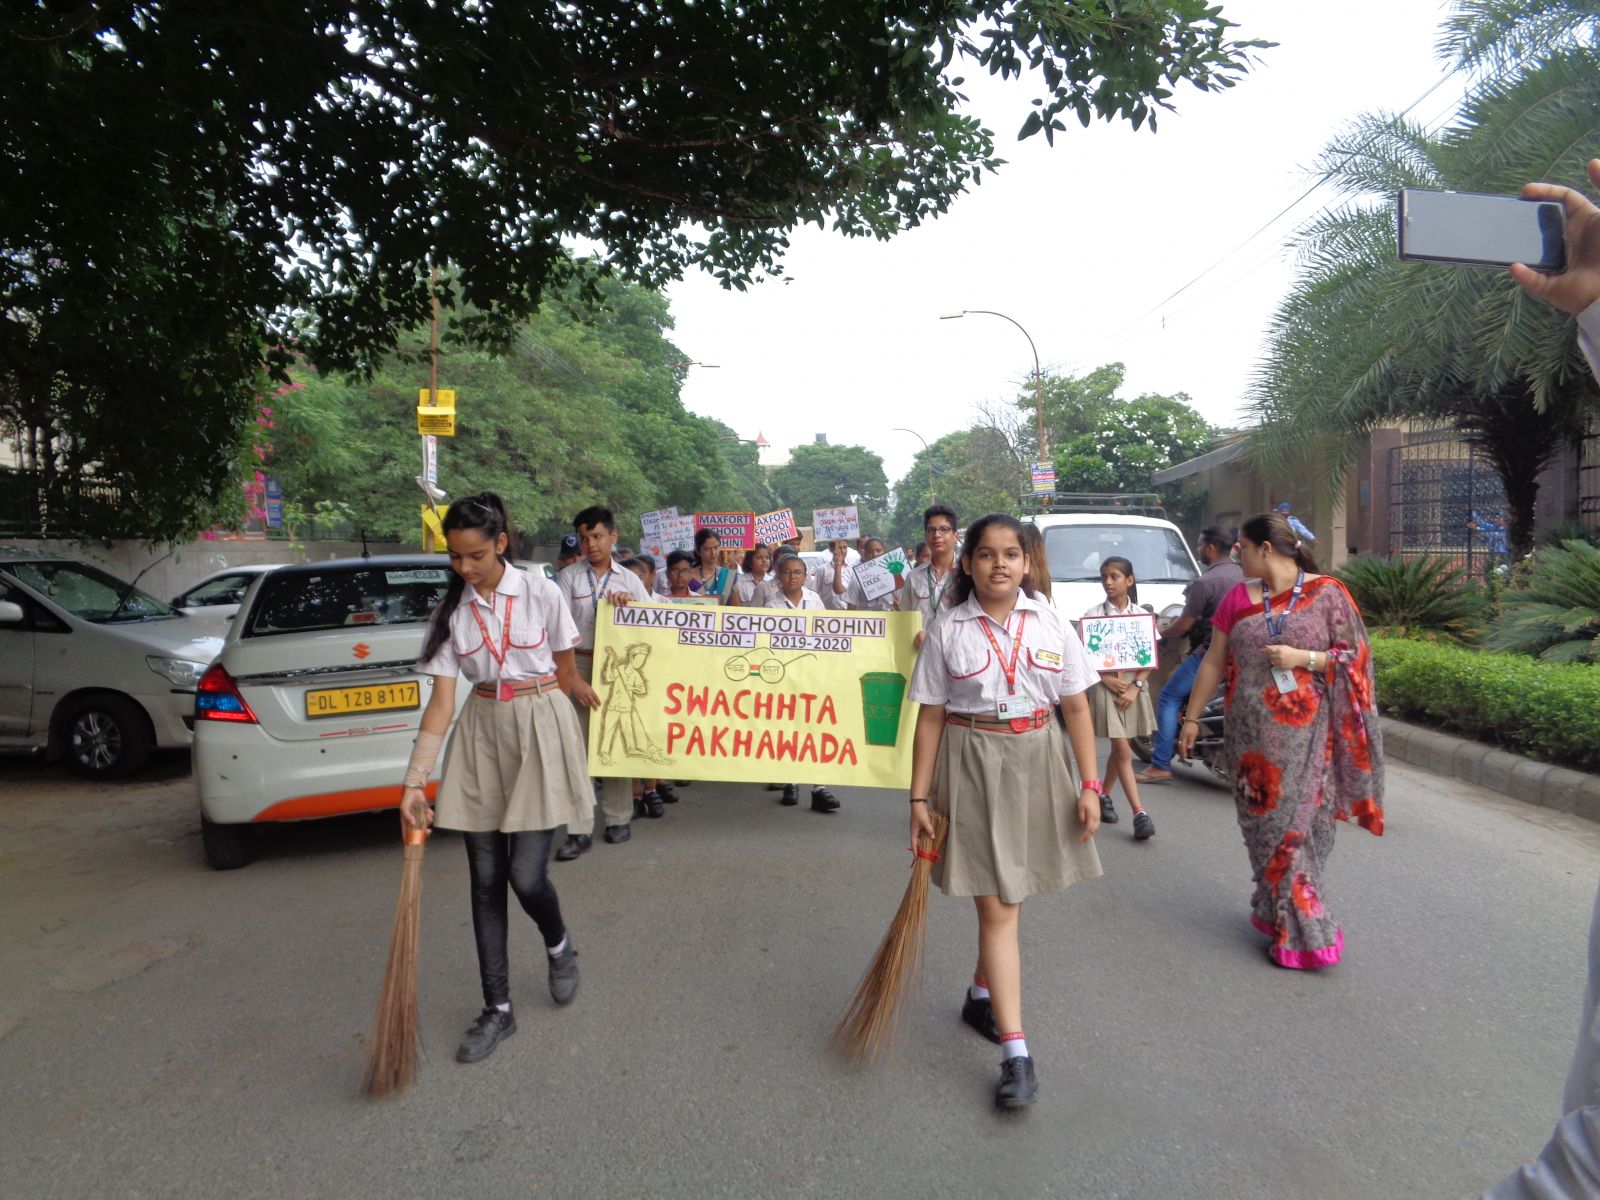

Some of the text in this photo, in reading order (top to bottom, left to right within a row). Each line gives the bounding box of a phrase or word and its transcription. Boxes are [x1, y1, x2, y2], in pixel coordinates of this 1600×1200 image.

[699, 515, 749, 524] MAXFORT
[755, 511, 790, 526] AXFORT
[755, 521, 789, 537] SCHOOL
[616, 608, 883, 635] MAXFORT SCHOOL ROHINI
[681, 631, 741, 645] SESSION
[772, 635, 849, 650] 2019-2020
[319, 695, 337, 710] DL
[377, 686, 415, 704] 8117
[664, 682, 837, 724] SWACHHTA
[667, 722, 857, 765] PAKHAWADA
